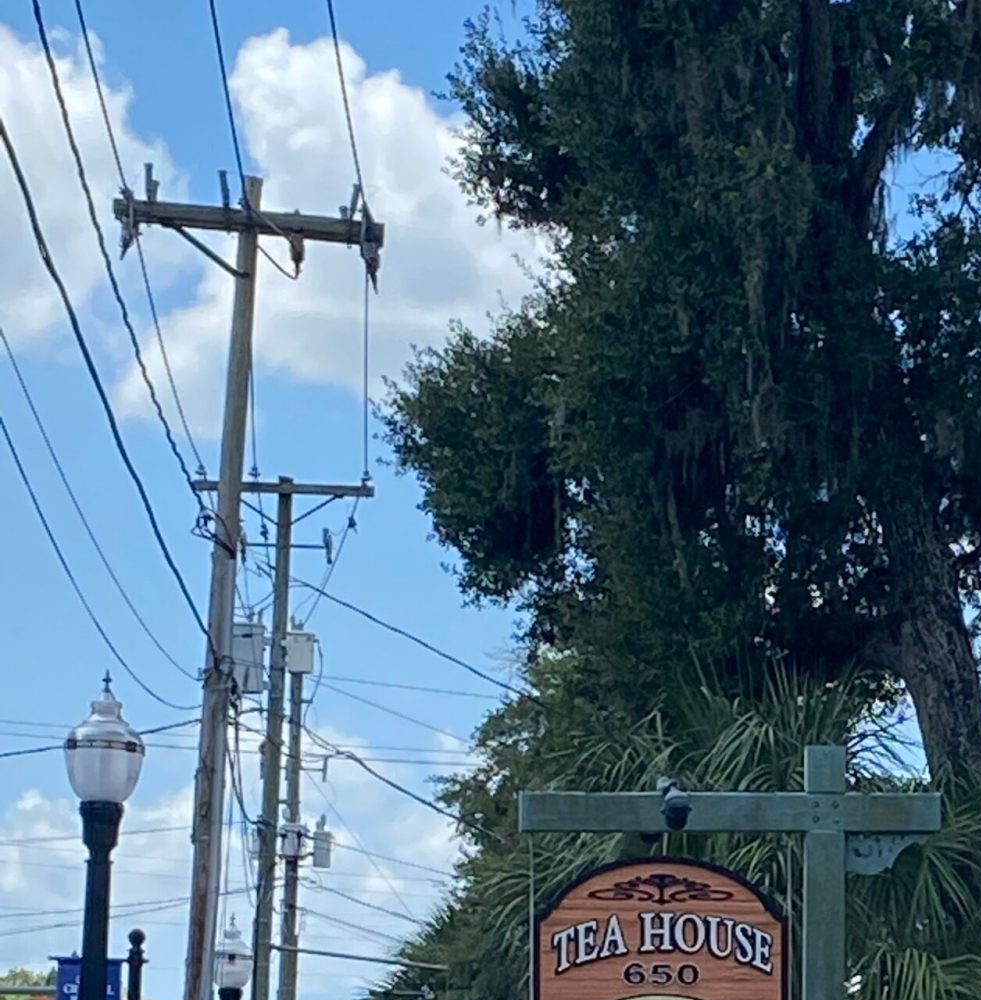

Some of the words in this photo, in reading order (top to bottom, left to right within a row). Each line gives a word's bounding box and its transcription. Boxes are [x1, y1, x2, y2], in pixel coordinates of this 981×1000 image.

[553, 914, 628, 974] TEA
[639, 911, 773, 975] HOUSE
[623, 963, 700, 986] 650
